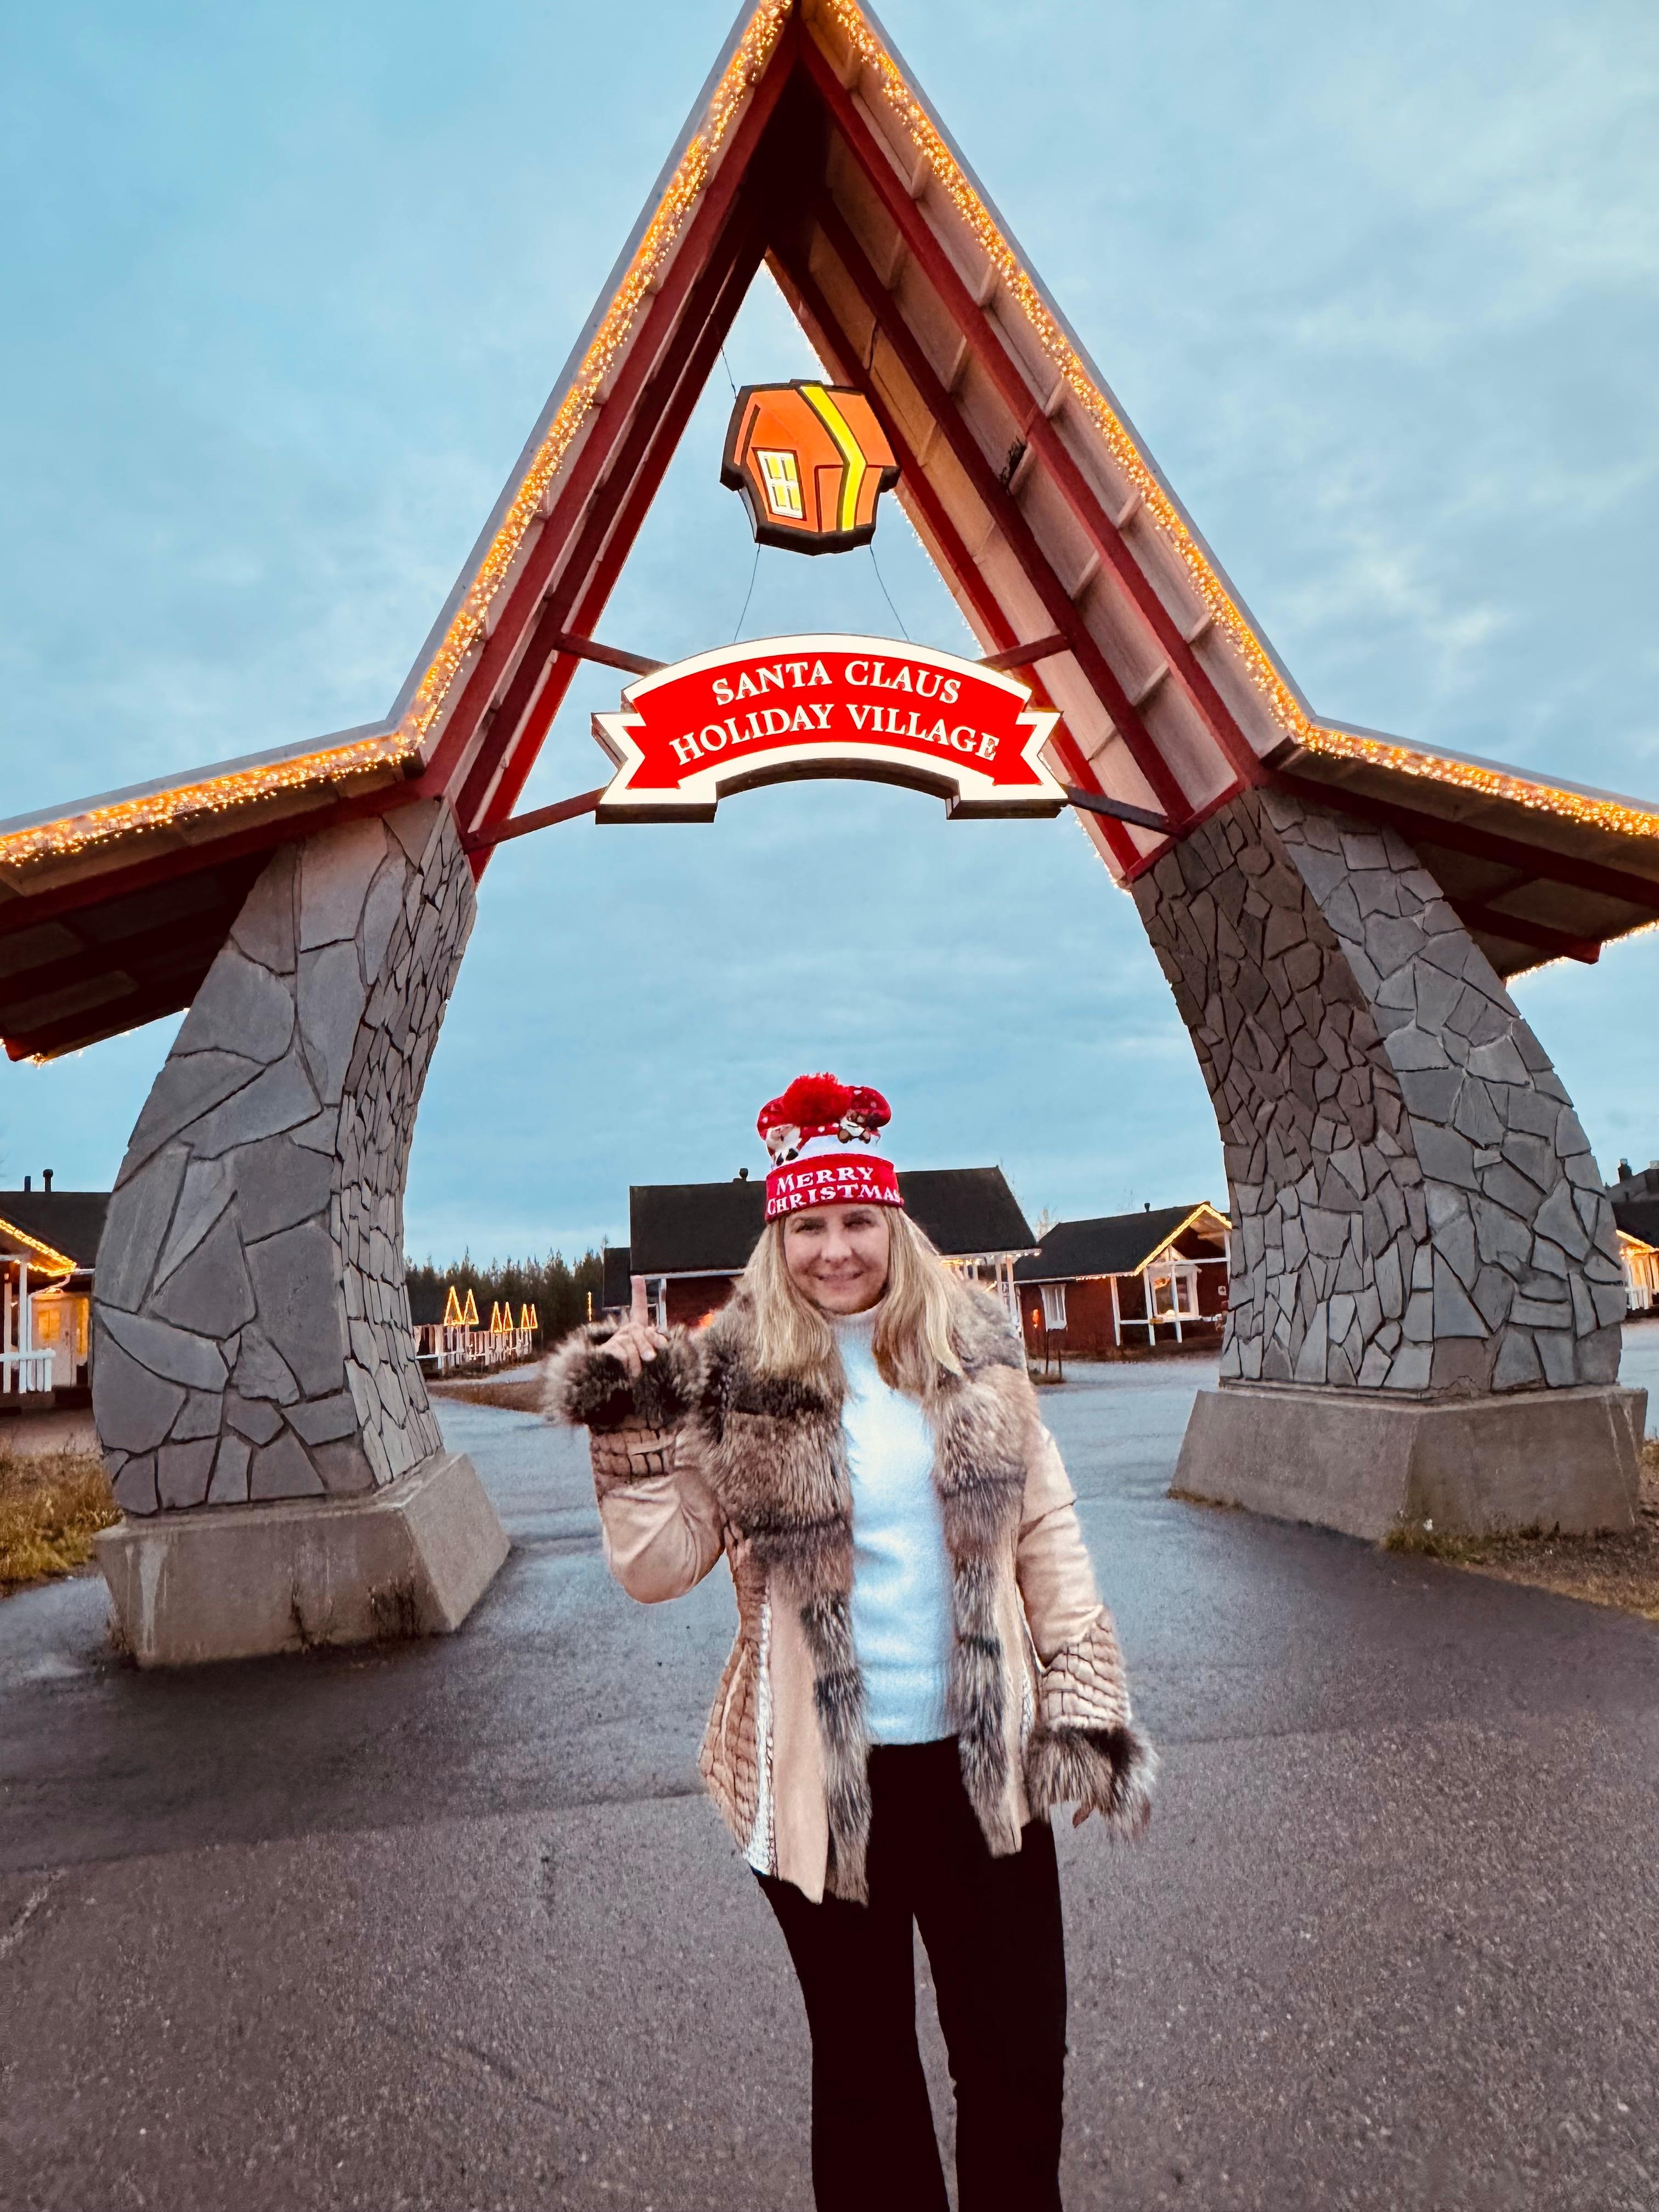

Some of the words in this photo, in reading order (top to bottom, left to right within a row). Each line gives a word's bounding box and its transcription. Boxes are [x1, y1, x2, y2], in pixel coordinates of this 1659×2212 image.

[712, 659, 832, 706] SANTA
[844, 660, 962, 704] CLAUS
[669, 703, 834, 766] HOLIDAY
[847, 703, 1000, 761] VILLAGE
[768, 1183, 901, 1215] CHRISTMAS
[776, 1166, 874, 1196] MERRY
